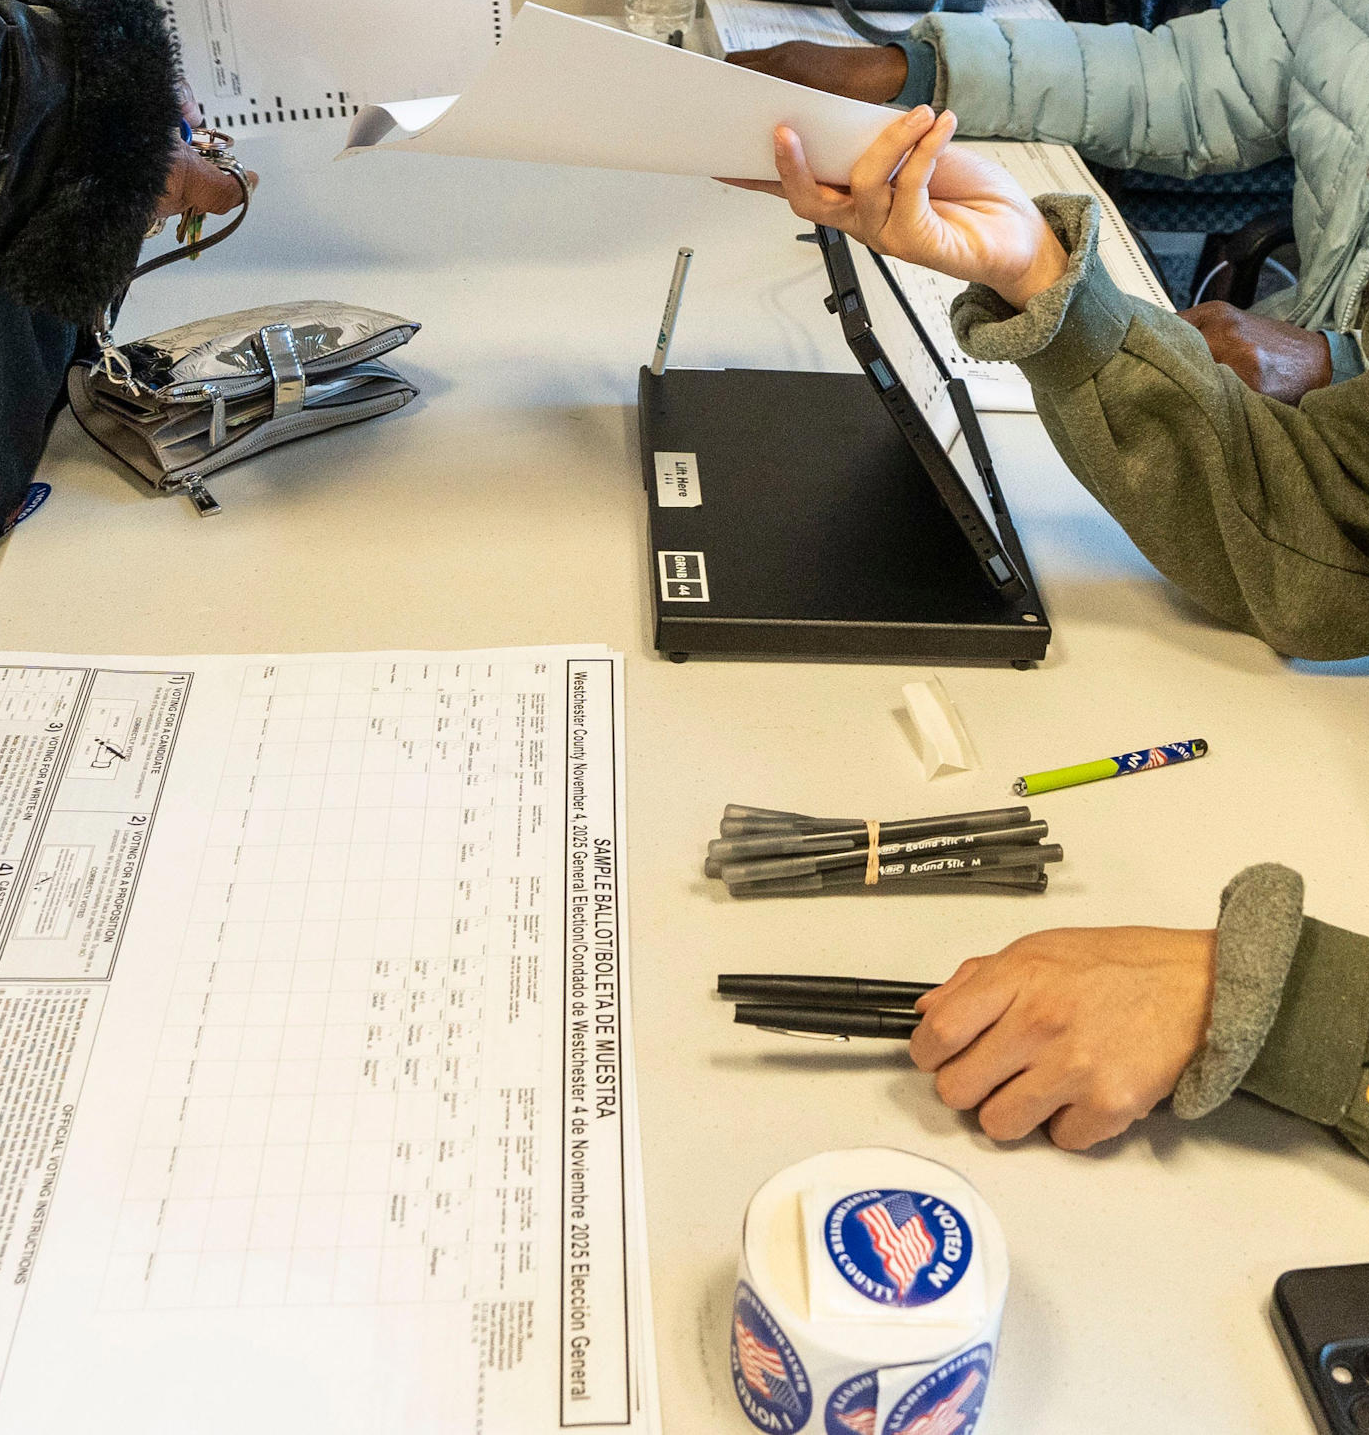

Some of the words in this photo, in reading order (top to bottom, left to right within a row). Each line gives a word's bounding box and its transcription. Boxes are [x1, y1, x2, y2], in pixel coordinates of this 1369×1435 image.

[675, 462, 686, 475] Lift
[676, 478, 688, 497] Here
[674, 556, 688, 579] GRNB
[678, 584, 691, 596] 44
[168, 676, 186, 684] 1)
[168, 687, 184, 711] VOTING
[573, 671, 588, 727] Westchester
[45, 722, 63, 733] 3)
[128, 717, 143, 744] CORRECTLY
[164, 713, 177, 726] FOR
[44, 736, 61, 761] VOTING
[150, 734, 171, 774] CANDIDATE
[570, 729, 587, 761] County
[38, 764, 51, 778] FOR
[573, 763, 587, 811] November
[22, 786, 43, 820] WRITE-IN
[128, 816, 146, 826] 2)
[570, 813, 587, 822] 4,
[127, 830, 145, 859] VOTING
[573, 825, 588, 848] 2025
[905, 840, 938, 852] Round
[941, 837, 959, 847] Stic
[965, 835, 974, 843] M
[122, 862, 135, 877] FOR
[573, 851, 588, 894] General
[593, 838, 612, 891] SAMPLE
[885, 864, 905, 875] BIC
[910, 862, 944, 873] Round
[947, 859, 965, 868] Stic
[972, 858, 981, 867] M
[83, 866, 99, 898] CORRECTLY
[77, 900, 89, 918] VOTED
[103, 887, 128, 942] PROPOSITION
[572, 896, 589, 999] Election/Condado
[594, 894, 614, 1010] BALLOT/BOLETA
[573, 1001, 588, 1016] de
[595, 1013, 614, 1035] DE
[572, 1020, 589, 1102] Westchester
[596, 1039, 616, 1119] MUESTRA
[572, 1106, 588, 1114] 4
[50, 1104, 74, 1152] OFFICIAL
[571, 1118, 589, 1135] de
[39, 1156, 60, 1197] VOTING
[571, 1139, 590, 1218] Noviembre
[920, 1196, 932, 1207] I
[14, 1200, 48, 1285] INSTRUCTIONS
[571, 1224, 589, 1259] 2025
[932, 1204, 963, 1263] VOTED
[838, 1253, 895, 1302] COUNTY
[928, 1261, 954, 1288] IN
[571, 1264, 592, 1331] Elección
[570, 1337, 591, 1401] General
[738, 1378, 783, 1431] VOTED
